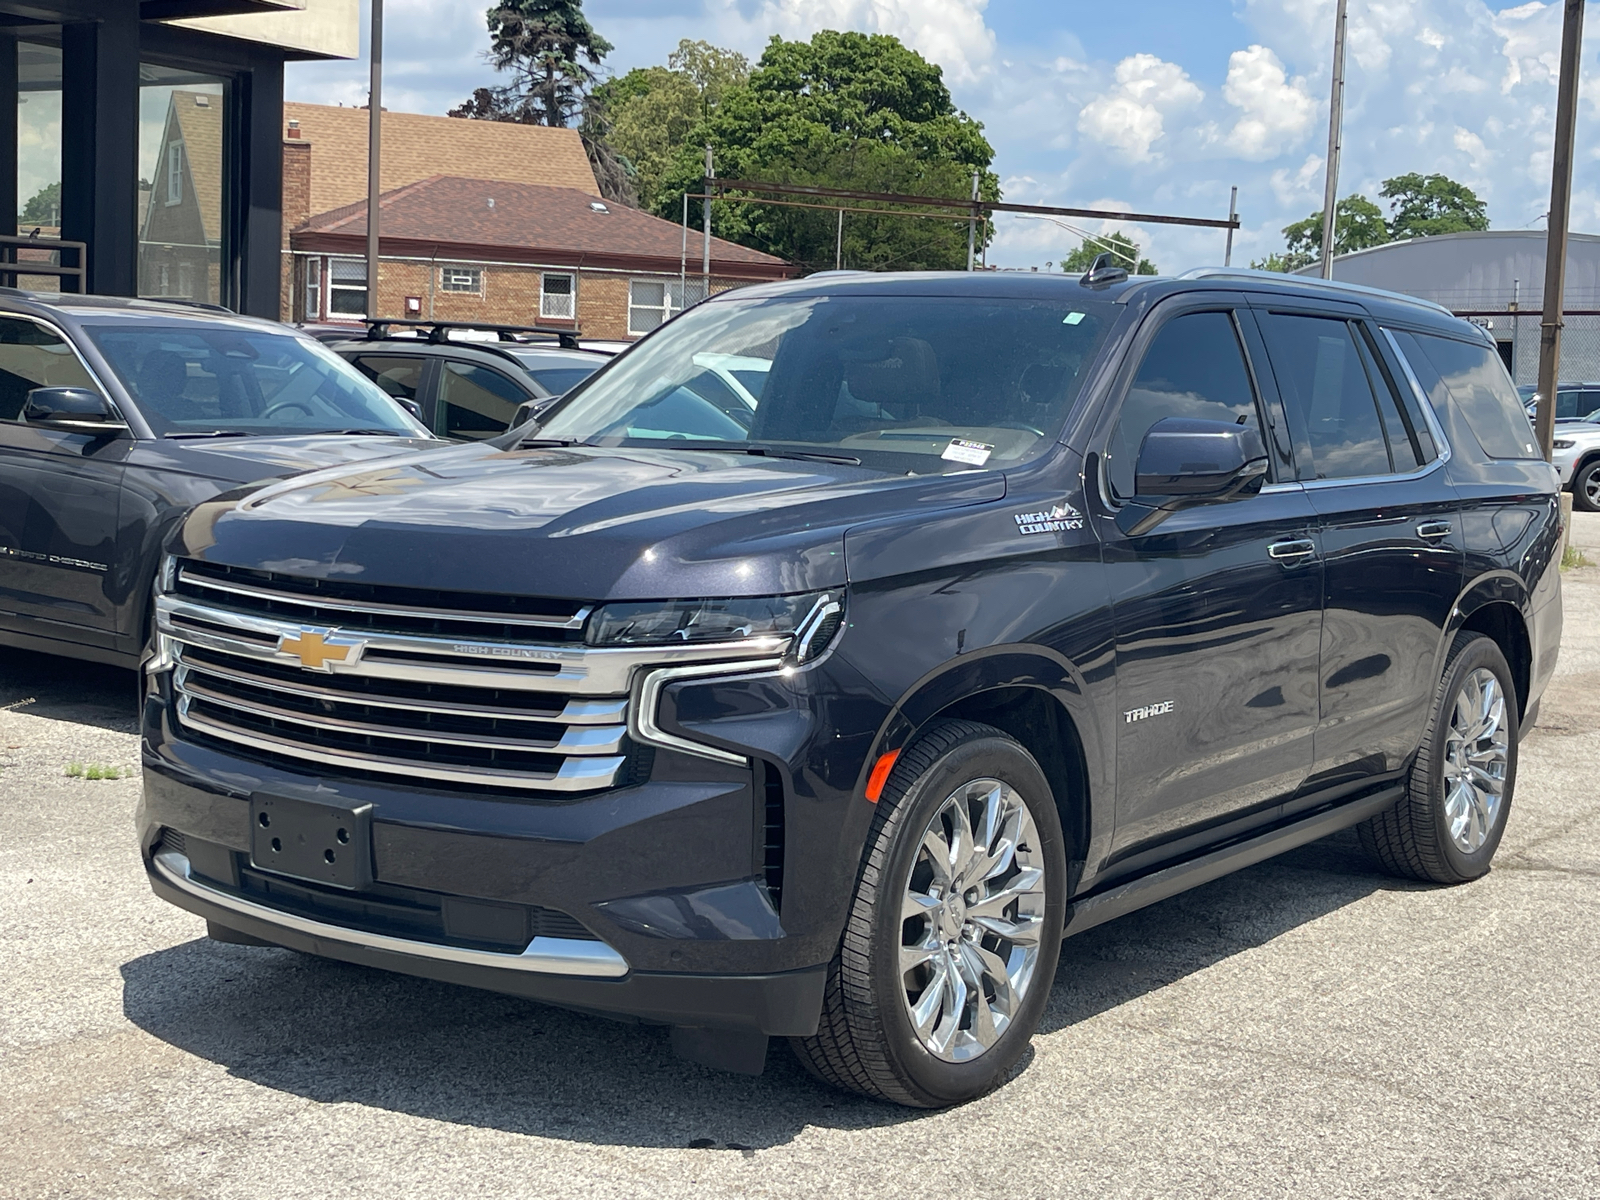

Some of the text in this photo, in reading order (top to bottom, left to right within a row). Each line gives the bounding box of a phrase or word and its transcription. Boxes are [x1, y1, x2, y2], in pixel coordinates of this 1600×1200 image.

[1014, 511, 1051, 525] HIGH
[1019, 519, 1084, 535] COUNTRY
[453, 644, 563, 660] HIGH COUNTRY
[1123, 700, 1174, 723] TAHOE
